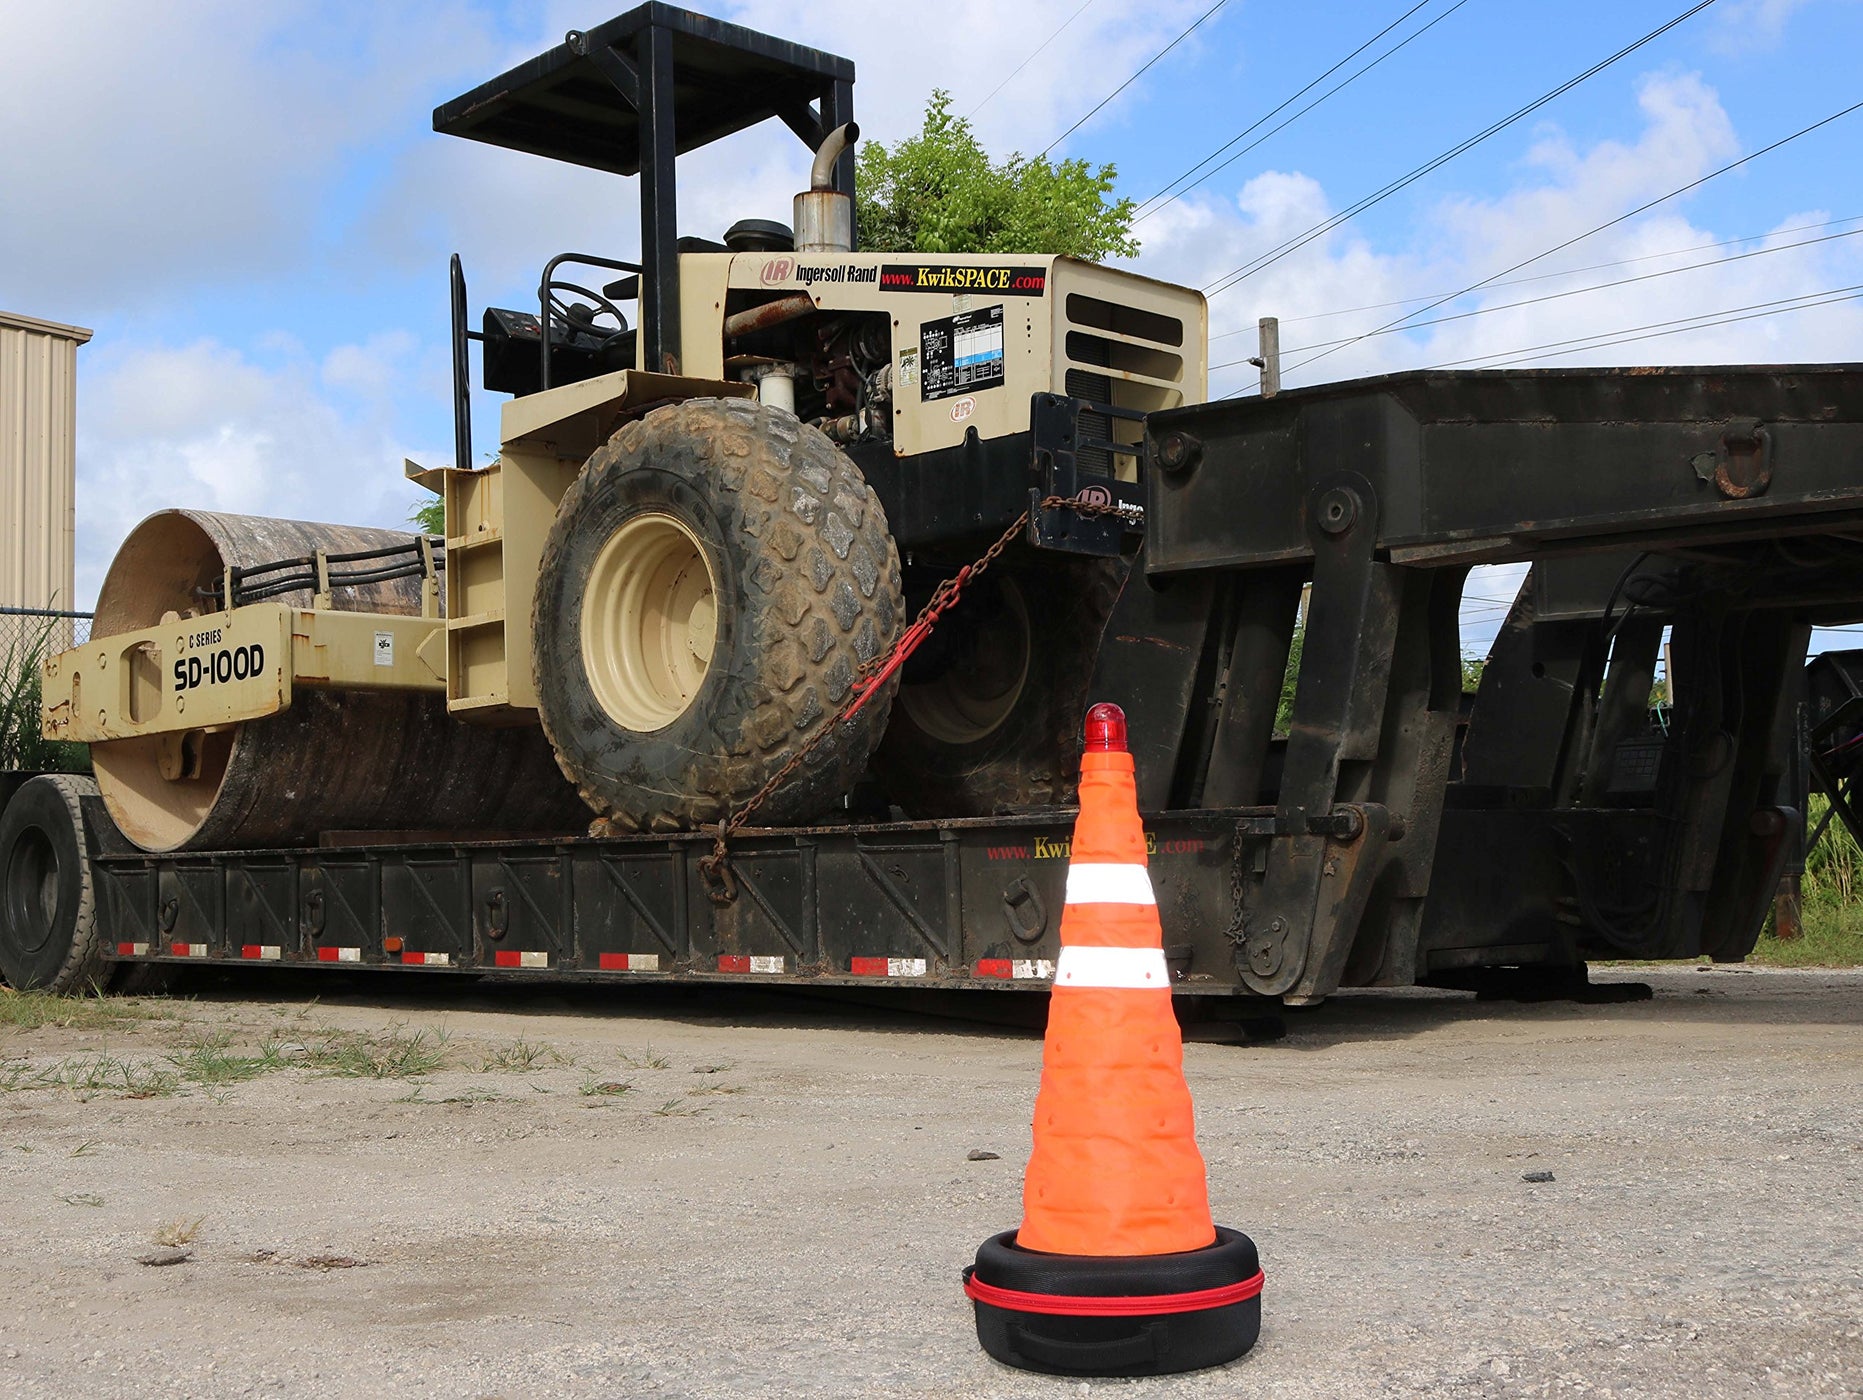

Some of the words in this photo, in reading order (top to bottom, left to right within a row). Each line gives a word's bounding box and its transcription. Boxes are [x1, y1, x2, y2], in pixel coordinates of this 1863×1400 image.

[764, 259, 790, 281] IR
[796, 264, 846, 286] Ingersoll
[847, 265, 878, 283] Rand
[189, 634, 194, 649] C
[196, 628, 222, 648] SERIES
[174, 643, 264, 691] SD-100D
